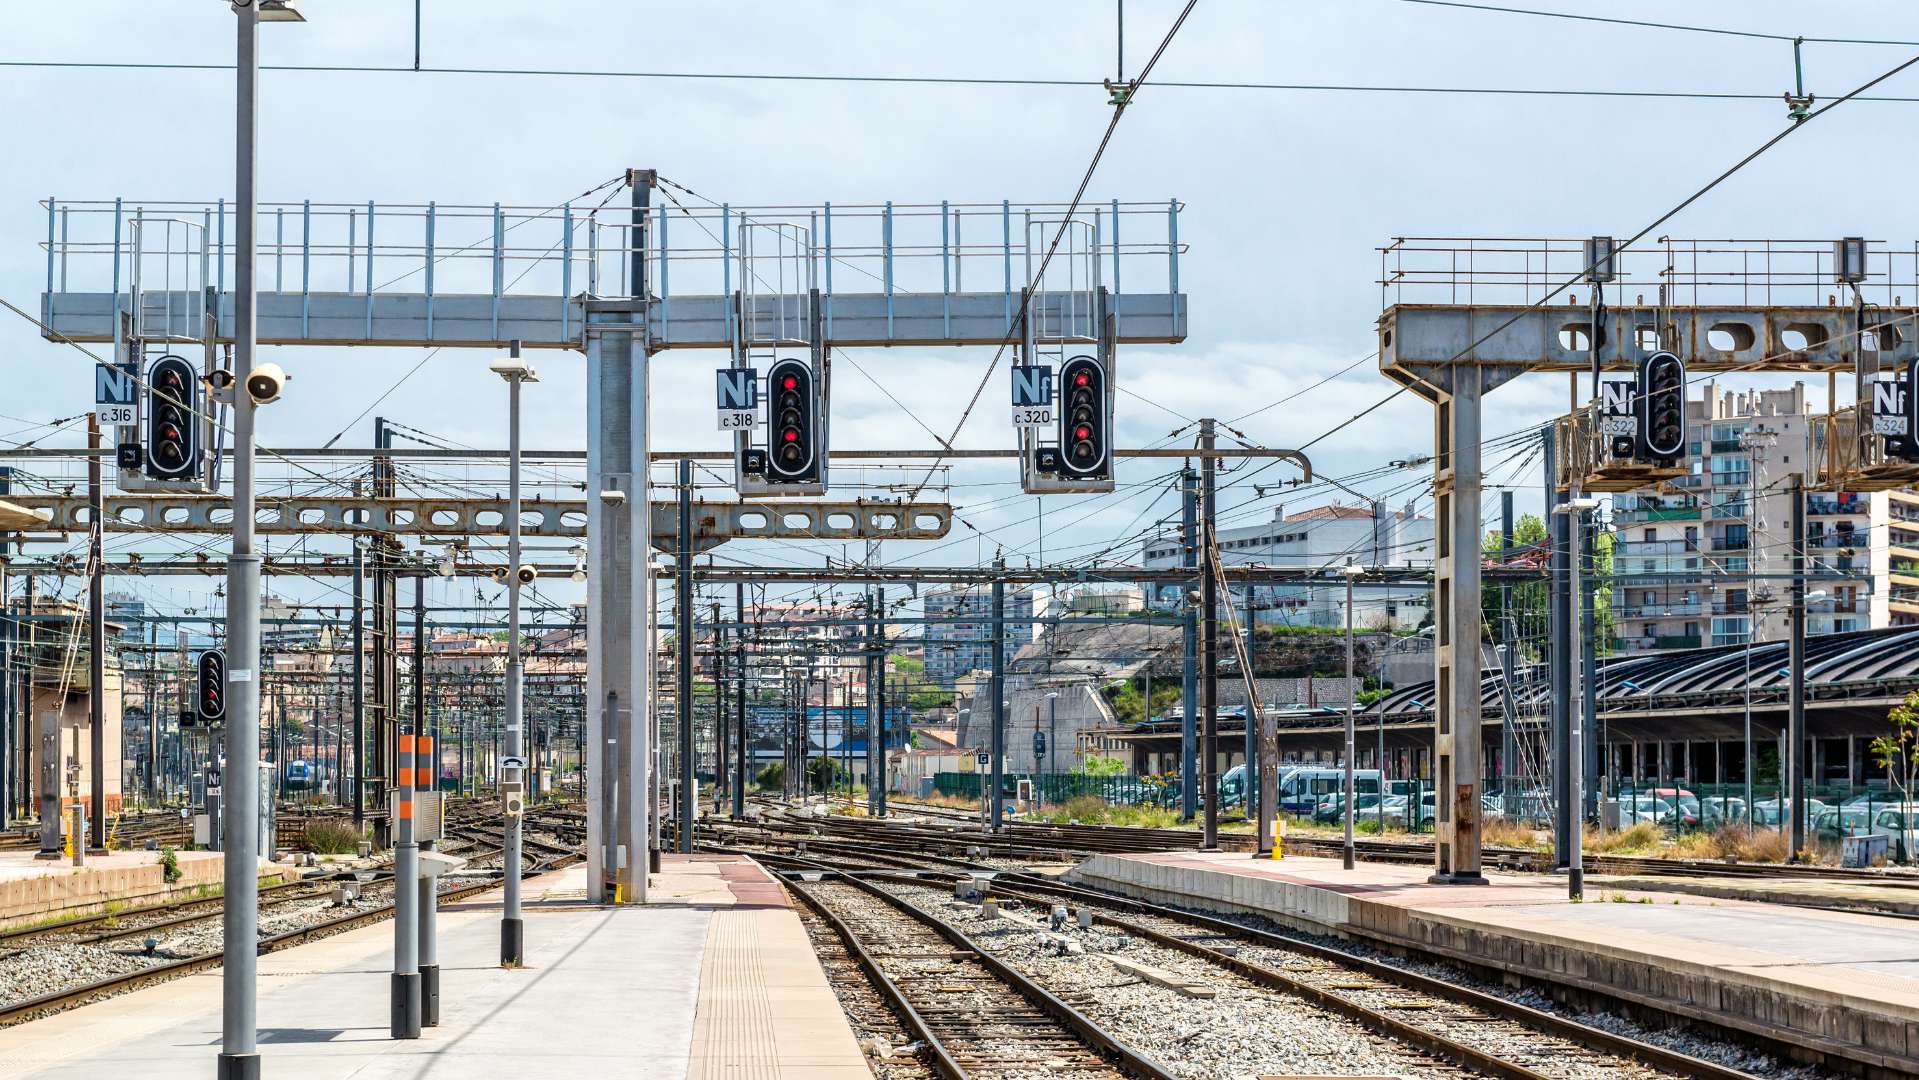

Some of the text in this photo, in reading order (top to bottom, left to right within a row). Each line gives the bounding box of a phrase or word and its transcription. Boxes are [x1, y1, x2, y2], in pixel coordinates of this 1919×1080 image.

[718, 372, 756, 406] Nf
[1012, 368, 1051, 403] Nf
[1603, 383, 1637, 414] Nf
[1874, 383, 1907, 414] Nf
[723, 413, 753, 427] c.318
[1015, 411, 1050, 424] c.320
